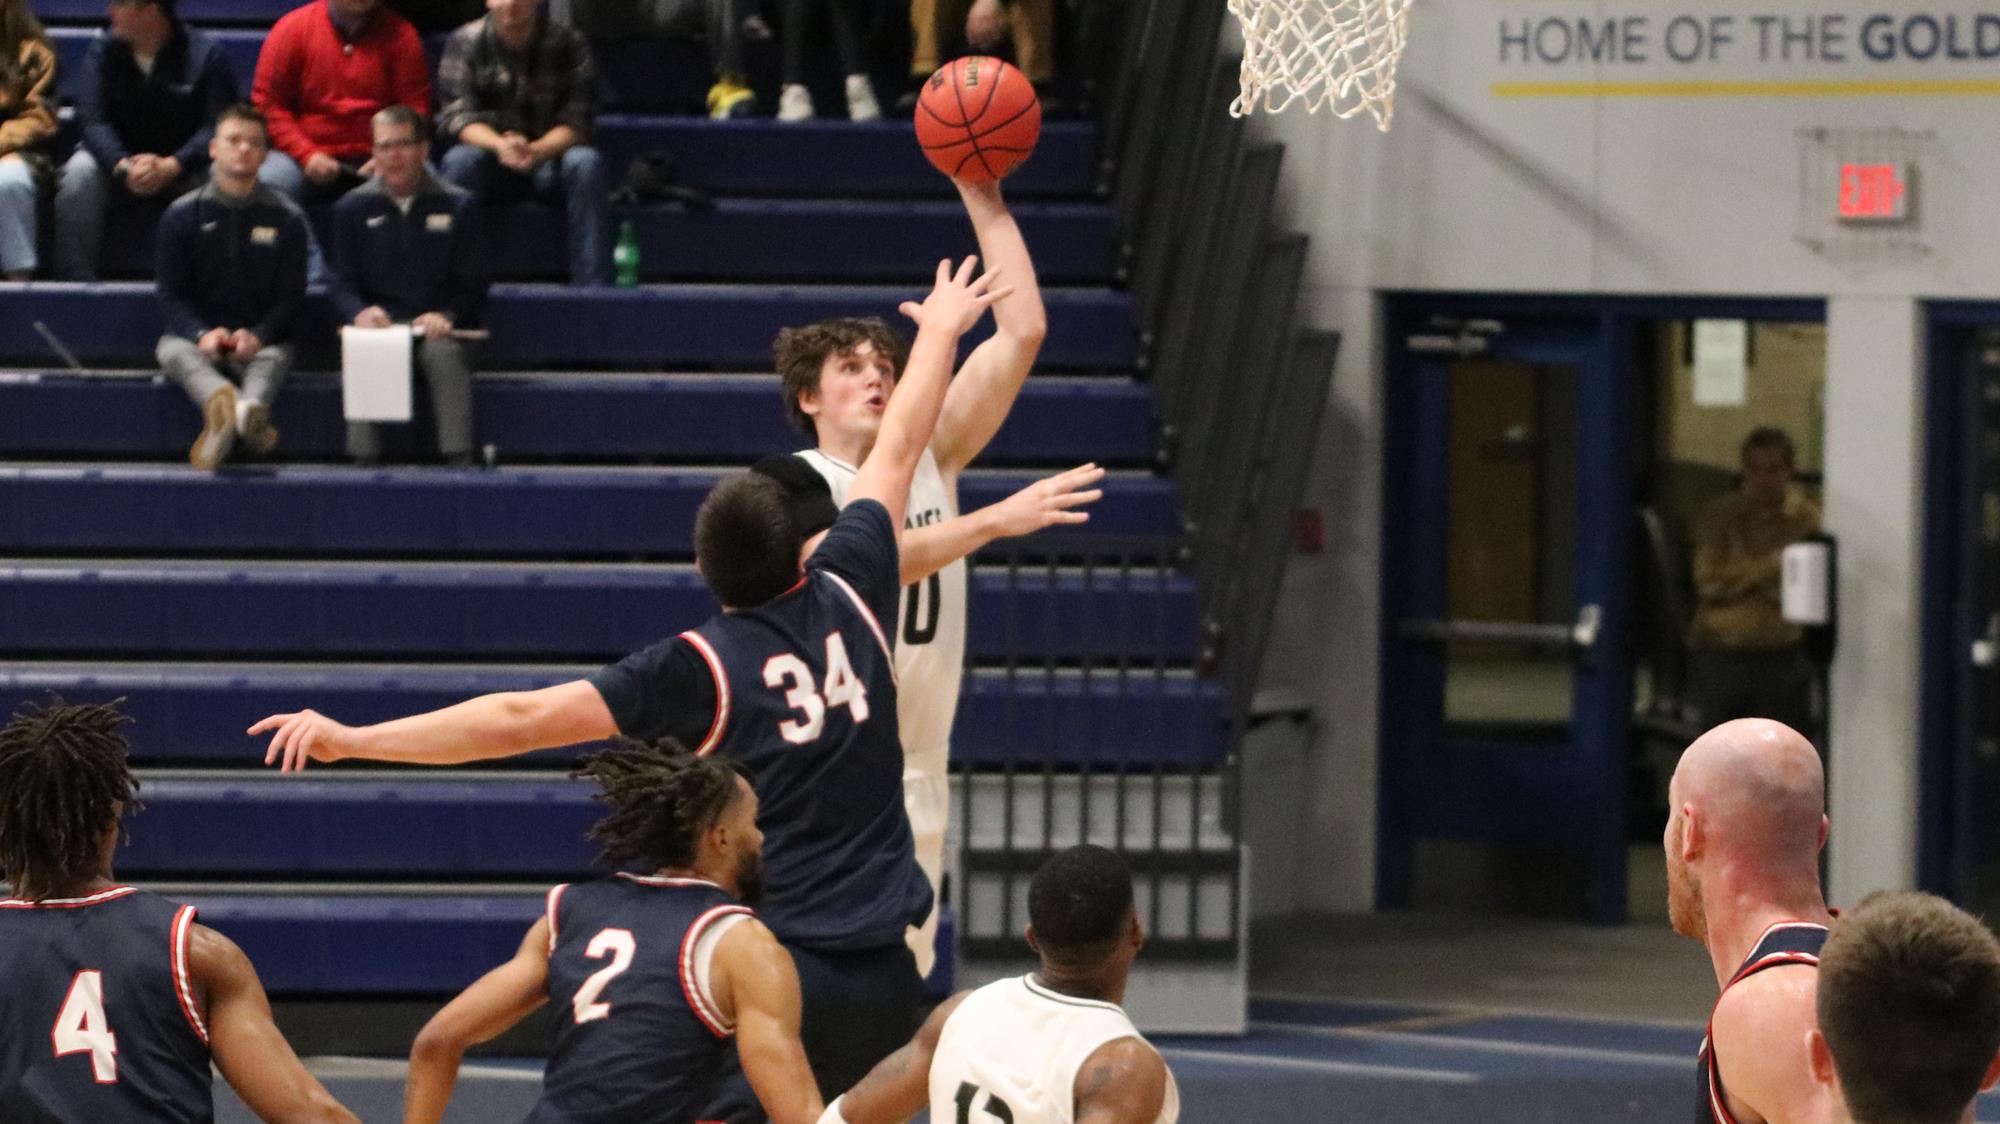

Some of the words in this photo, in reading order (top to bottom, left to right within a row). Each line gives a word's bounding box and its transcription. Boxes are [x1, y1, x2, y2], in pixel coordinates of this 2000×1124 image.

[1501, 16, 1648, 64] HOME
[1665, 15, 1733, 64] OF
[1751, 15, 1846, 62] THE
[1859, 13, 2000, 61] GOLD
[761, 628, 870, 745] 34
[51, 968, 119, 1085] 4
[572, 927, 637, 1025] 2
